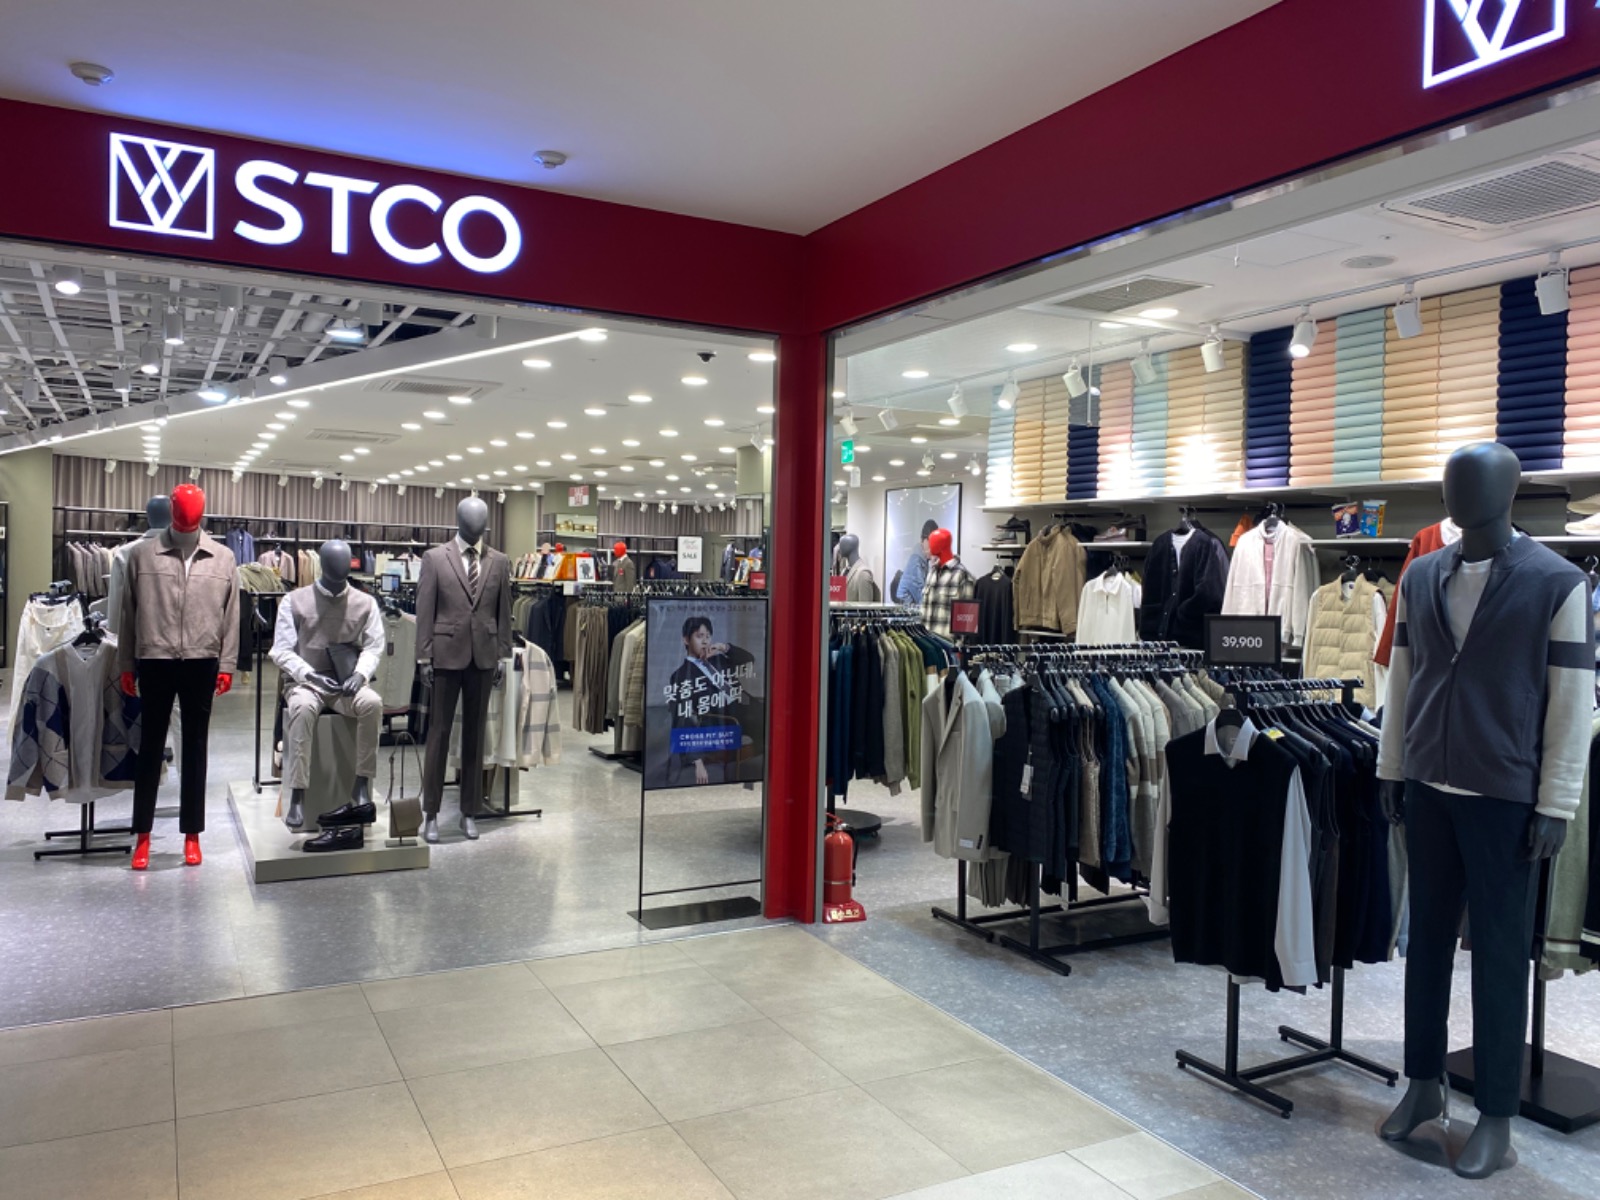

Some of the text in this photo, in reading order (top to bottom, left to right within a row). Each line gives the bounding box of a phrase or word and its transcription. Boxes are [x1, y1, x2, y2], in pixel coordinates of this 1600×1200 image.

[232, 158, 522, 274] STCO
[1222, 636, 1263, 649] 39,900
[663, 676, 708, 704] 맞춤도
[677, 699, 693, 718] 내
[697, 690, 725, 715] 몸에
